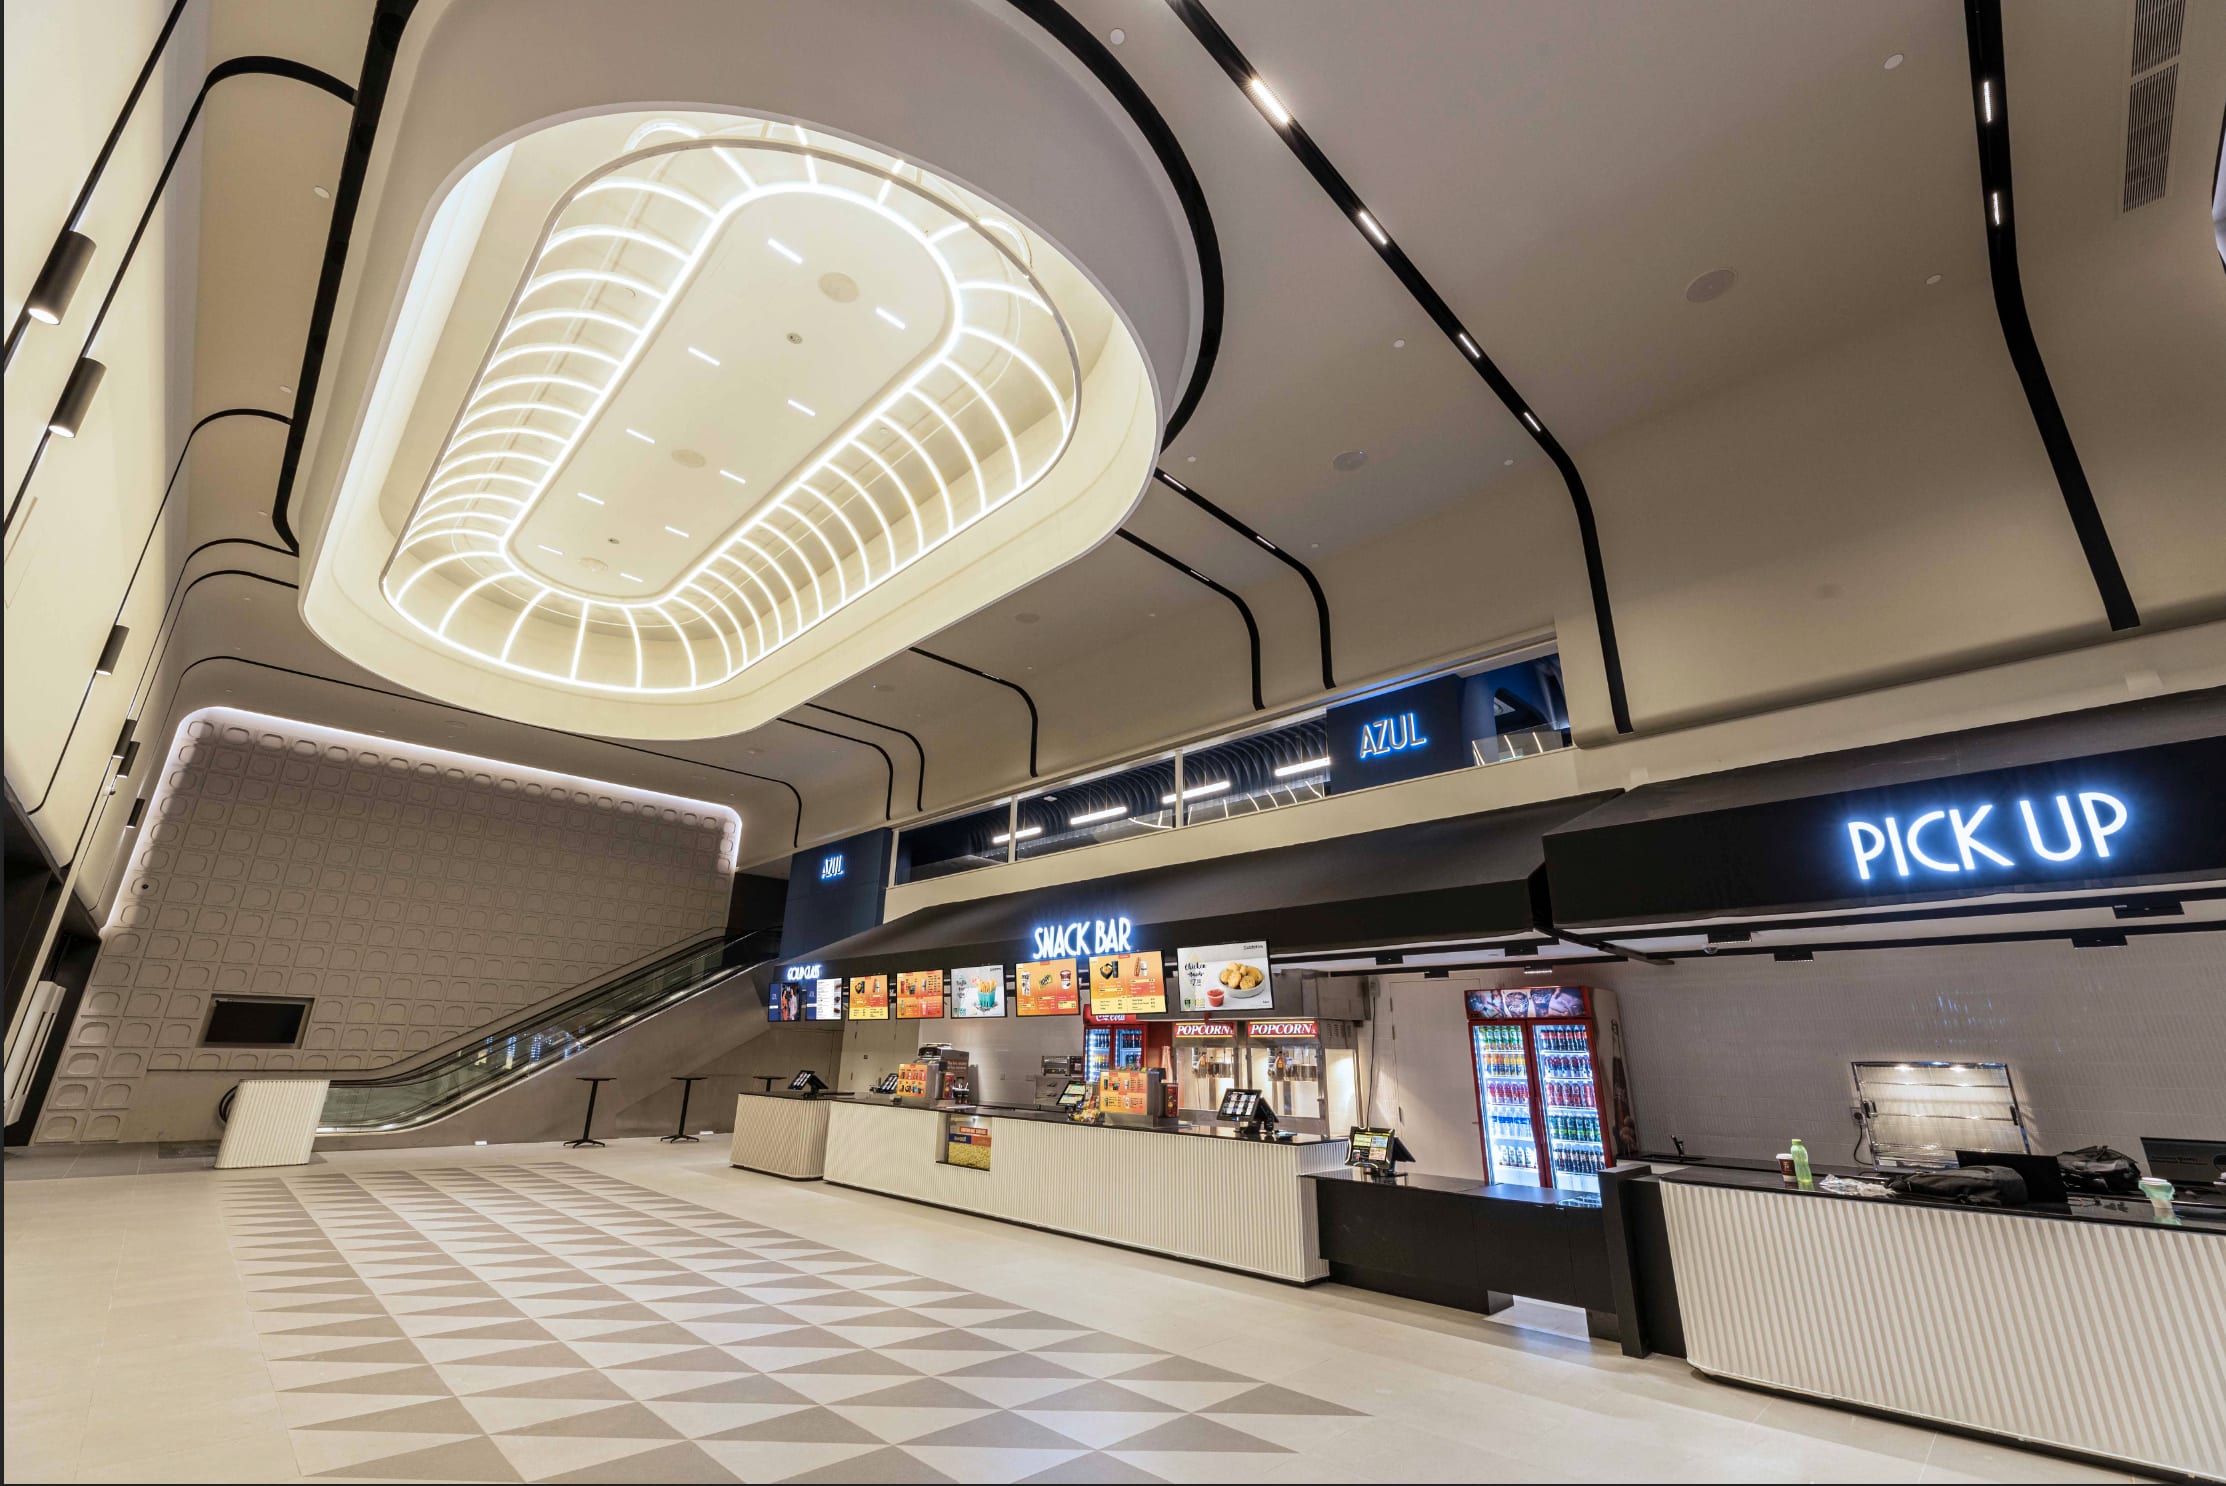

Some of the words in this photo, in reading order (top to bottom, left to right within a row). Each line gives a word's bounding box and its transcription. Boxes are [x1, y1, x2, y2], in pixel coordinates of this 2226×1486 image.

[1360, 712, 1427, 758] AZUL
[1847, 803, 2015, 880] PICK
[2019, 791, 2128, 862] UP
[1032, 921, 1091, 960] SNACK
[1095, 917, 1131, 954] BAR
[1176, 1023, 1230, 1036] POPCORN
[1250, 1023, 1313, 1035] POPCORN
